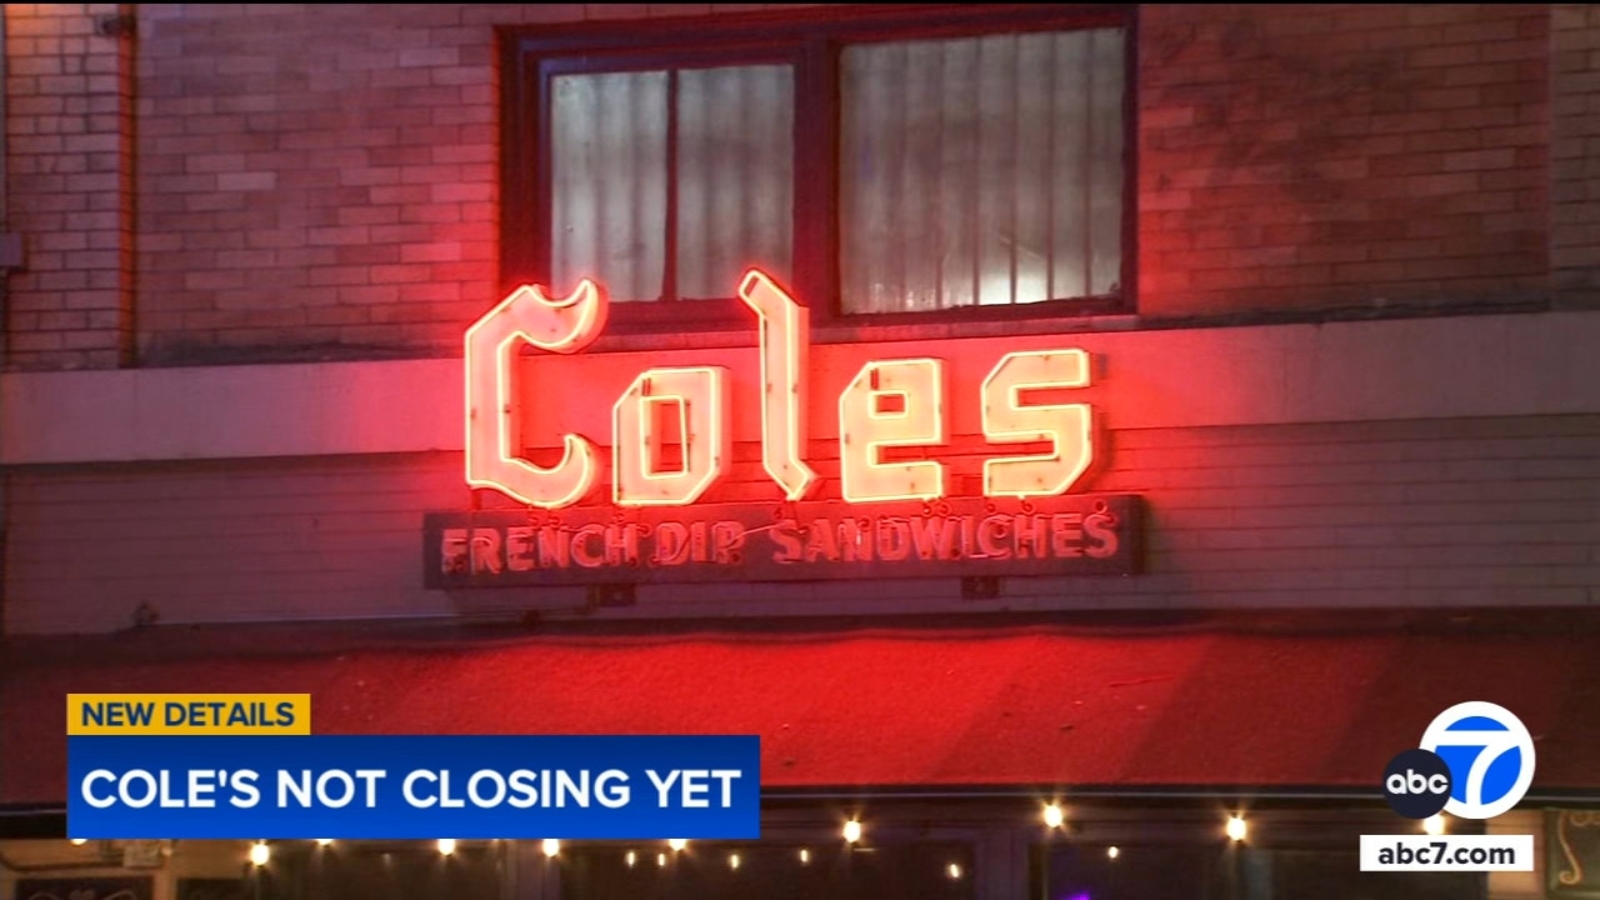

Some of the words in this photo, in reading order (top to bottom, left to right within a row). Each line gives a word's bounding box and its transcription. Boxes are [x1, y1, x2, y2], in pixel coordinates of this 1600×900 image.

[463, 269, 1098, 508] Coles
[441, 522, 638, 574] FRENCH
[654, 520, 742, 564] DIP
[769, 513, 1119, 563] SANDWICHES
